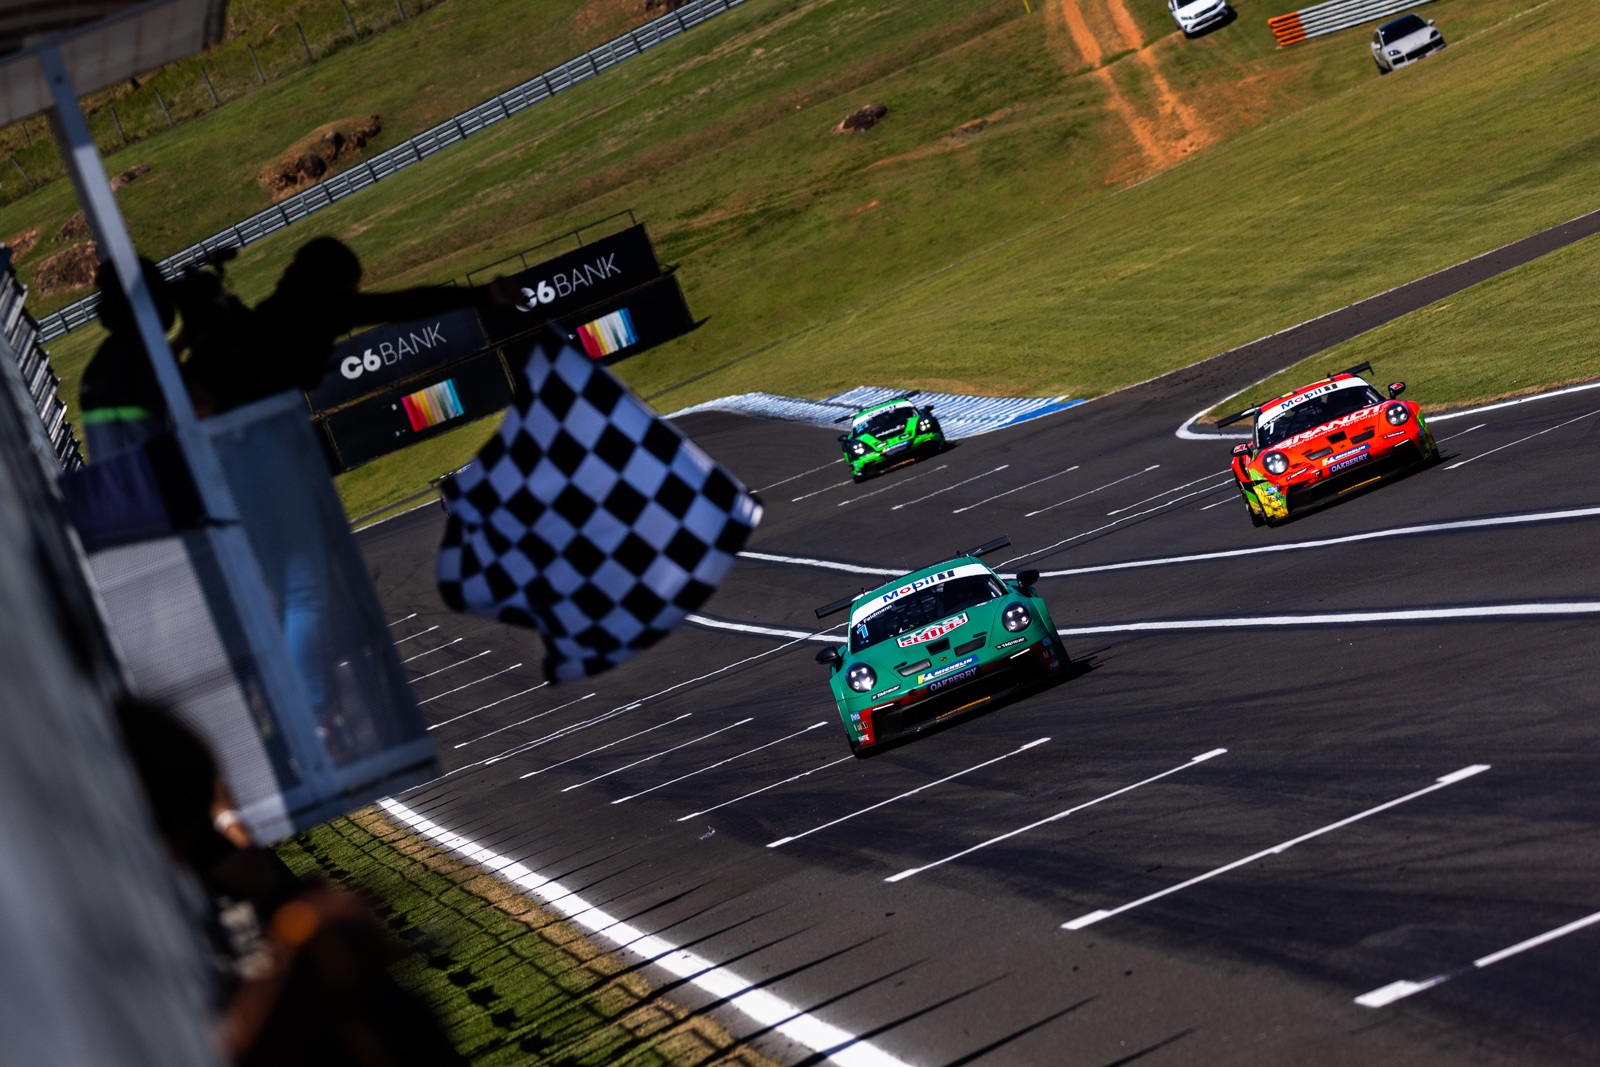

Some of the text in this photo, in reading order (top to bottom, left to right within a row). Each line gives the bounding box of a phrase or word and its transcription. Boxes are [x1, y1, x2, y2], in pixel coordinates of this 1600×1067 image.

[1280, 388, 1322, 410] Mobil
[1264, 422, 1275, 435] 7
[1288, 408, 1384, 449] Professional Agriculture
[1331, 453, 1368, 472] OAKBERRY
[1335, 445, 1366, 460] MICHELIN
[882, 576, 935, 603] Mobil
[863, 605, 893, 623] Feldmann
[901, 618, 966, 647] HEUER
[934, 657, 973, 676] MICHELIN
[930, 667, 977, 692] OAKBERRY
